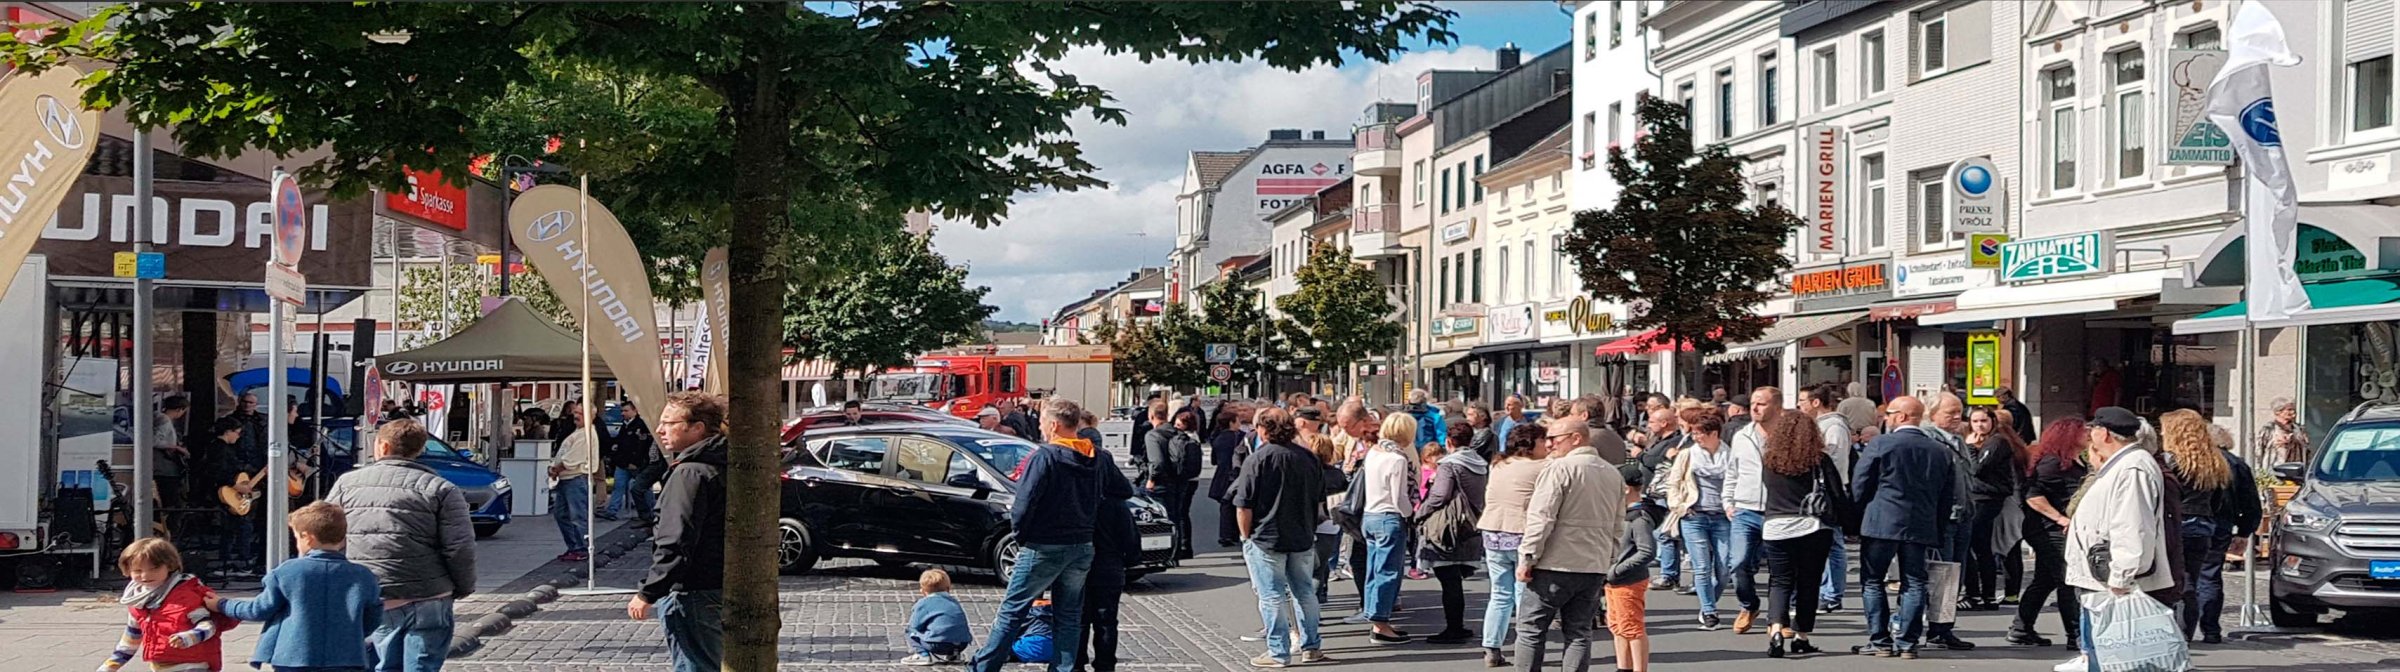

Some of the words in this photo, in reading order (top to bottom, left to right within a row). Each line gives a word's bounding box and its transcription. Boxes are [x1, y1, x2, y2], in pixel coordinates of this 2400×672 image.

[1262, 164, 1305, 175] AGFA
[1819, 128, 1834, 176] GRILL
[2170, 149, 2230, 161] ZAMMATTEO
[420, 187, 454, 214] Sparkasse
[1260, 200, 1292, 209] FOT
[1819, 181, 1834, 250] MARIEN
[41, 193, 328, 251] UNDI
[1845, 263, 1885, 288] GRILL
[2005, 235, 2096, 277] ZAMMATTEO
[556, 240, 644, 343] HYUNDAI
[714, 281, 729, 357] HYUND
[1569, 295, 1613, 334] Plum
[422, 359, 503, 373] HYUNDAI
[691, 317, 711, 379] Maltes
[1216, 369, 1226, 377] 30
